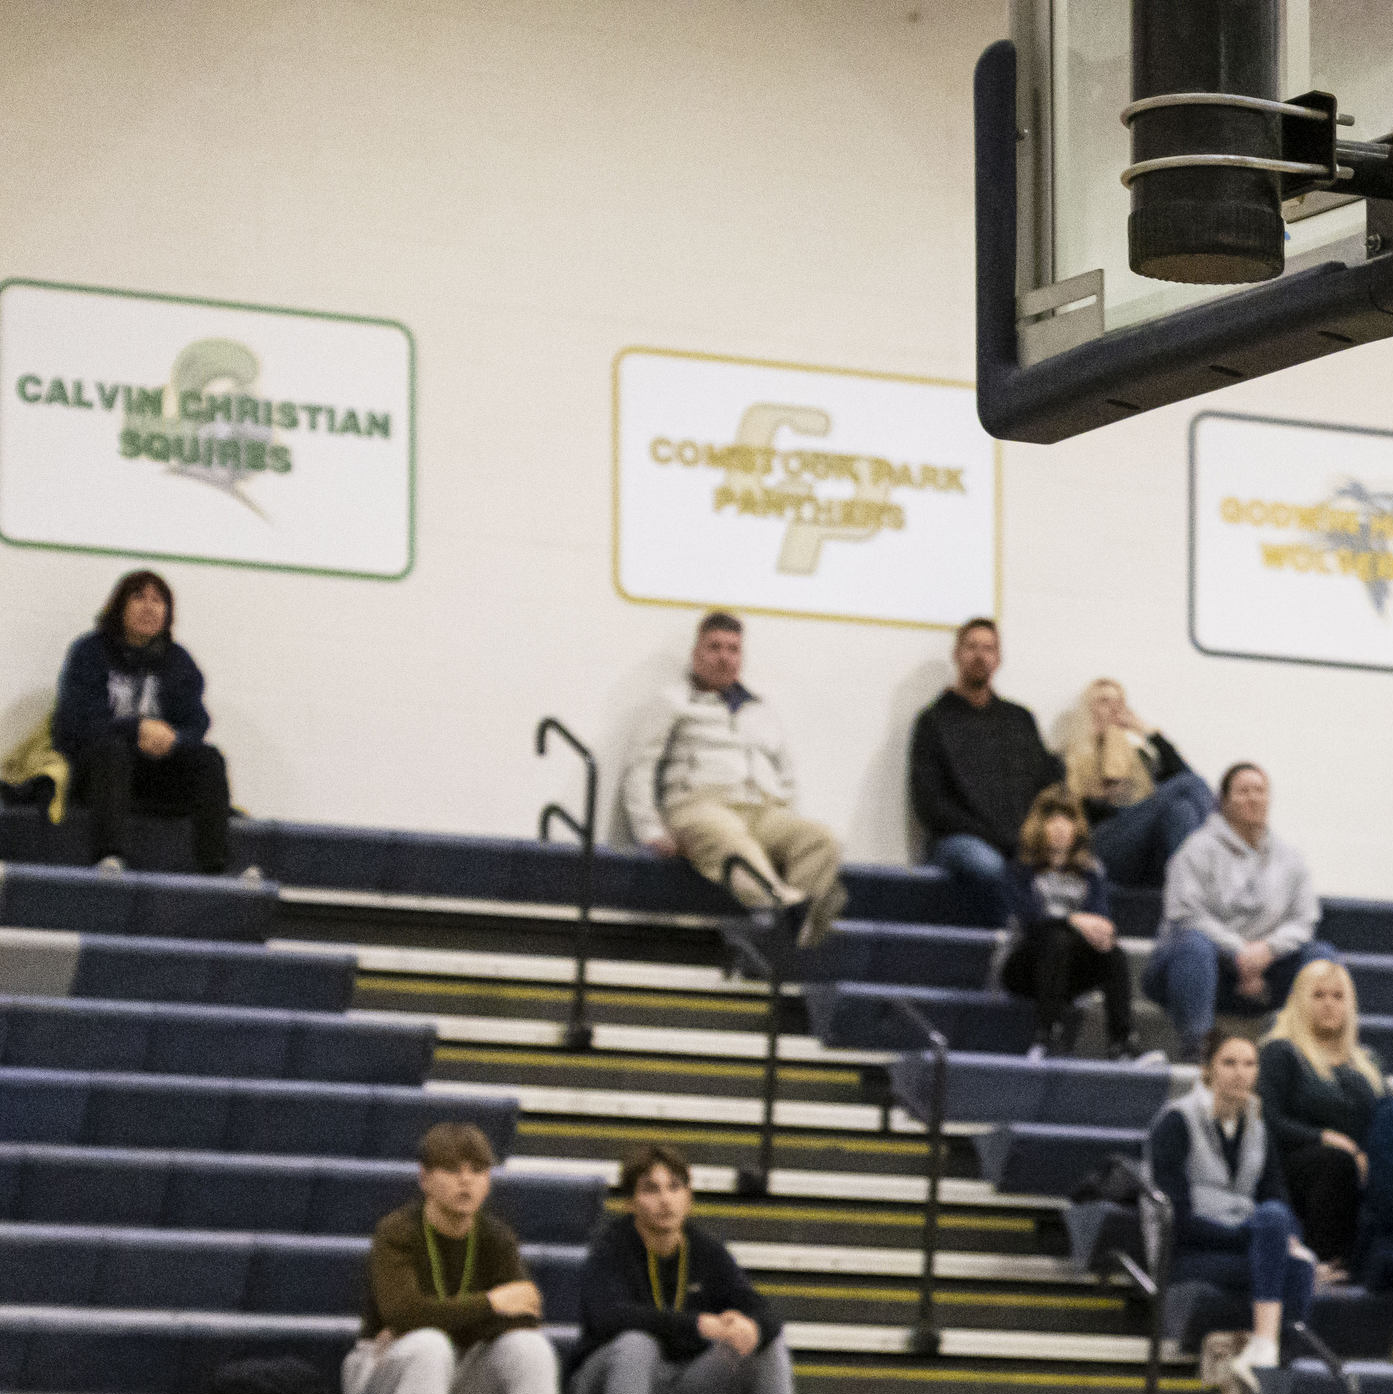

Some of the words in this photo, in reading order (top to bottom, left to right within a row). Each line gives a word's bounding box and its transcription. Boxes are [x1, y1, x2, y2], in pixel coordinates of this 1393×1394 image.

[16, 374, 165, 419] CALVIN
[178, 390, 392, 439] CHRISTIAN
[118, 428, 294, 474] SQUIRES
[871, 458, 967, 494] PARK
